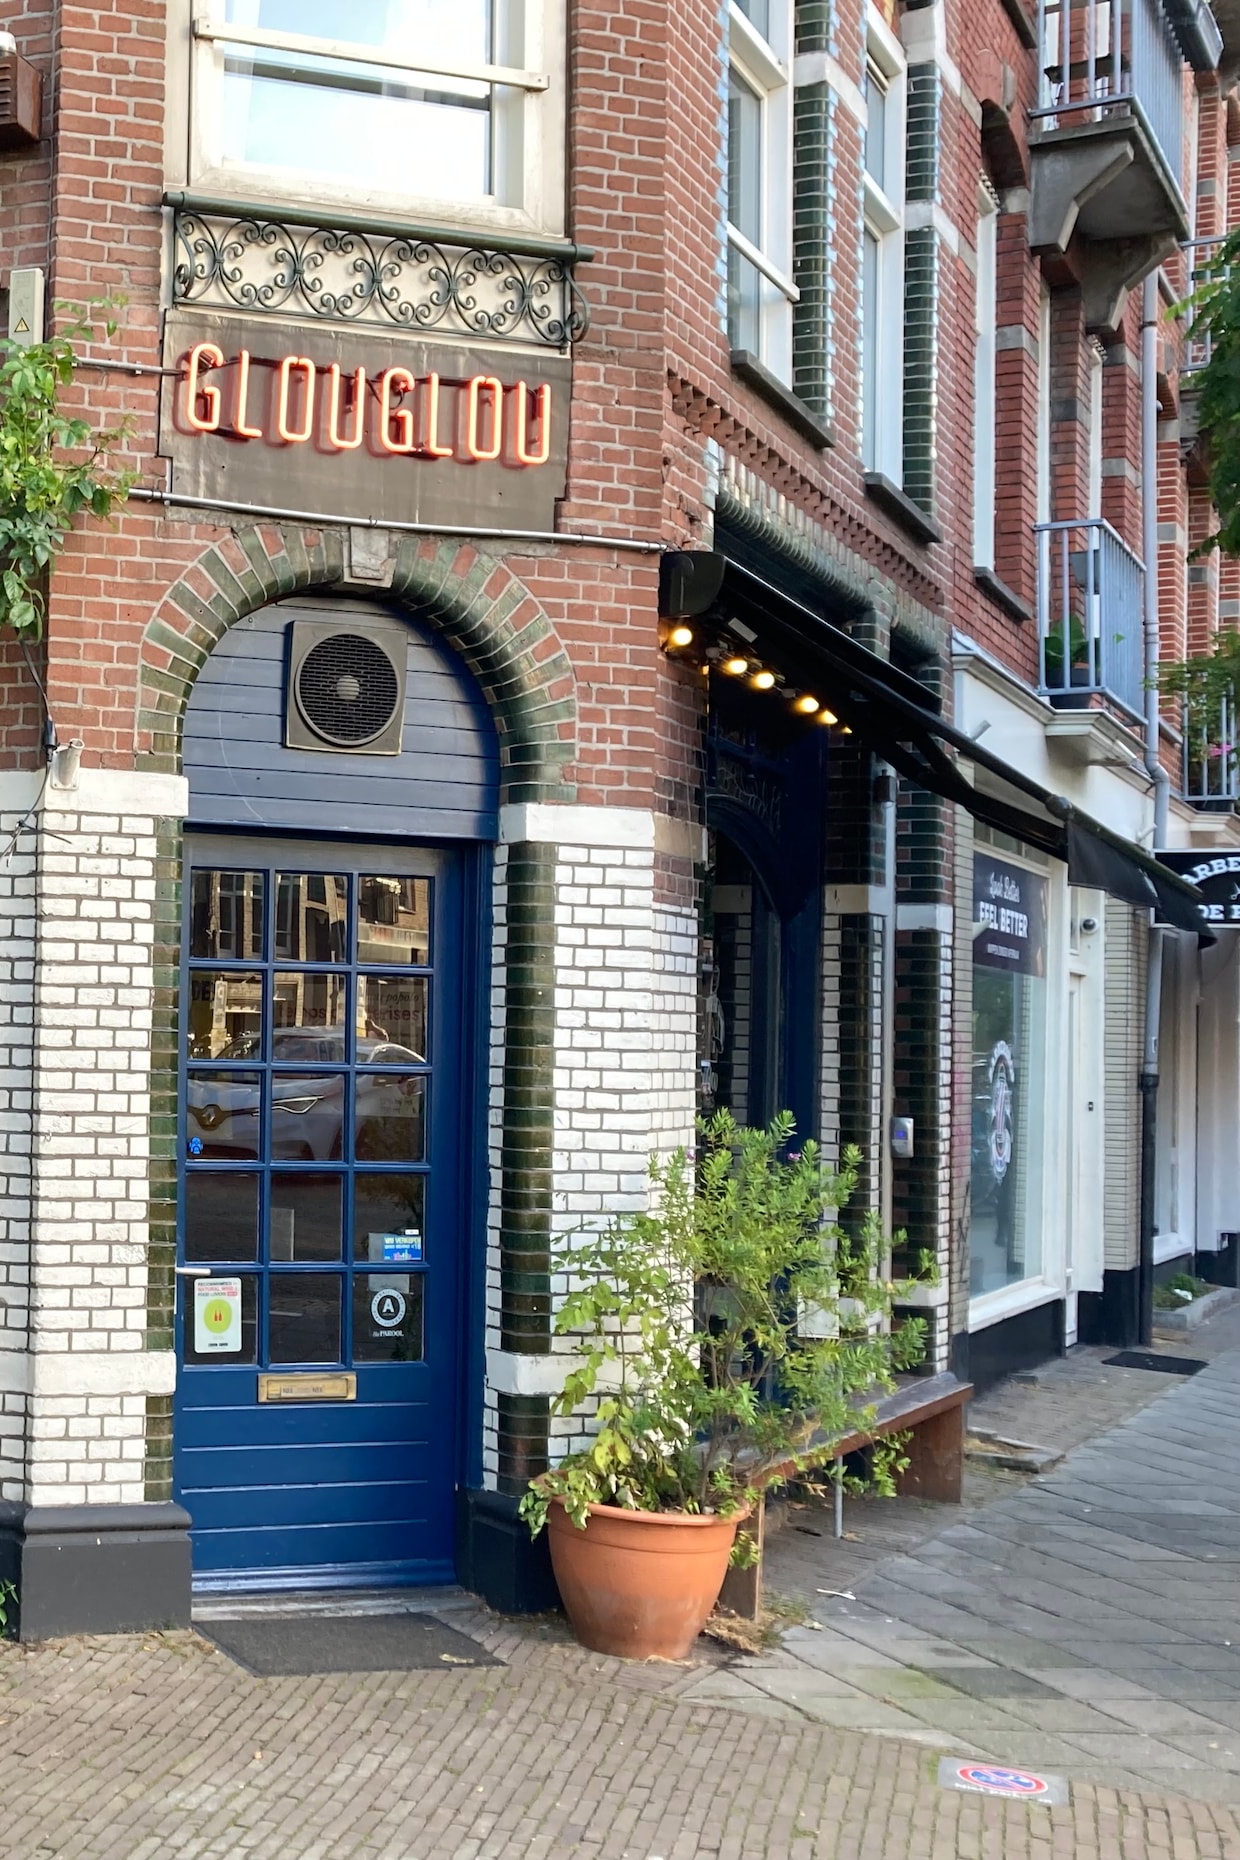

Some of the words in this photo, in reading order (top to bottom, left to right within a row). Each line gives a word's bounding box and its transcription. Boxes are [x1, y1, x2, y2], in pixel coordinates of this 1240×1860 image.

[185, 342, 552, 465] GLOUGLOU
[980, 901, 999, 930] FEEL
[1001, 907, 1028, 938] BETTER
[382, 1297, 395, 1313] A
